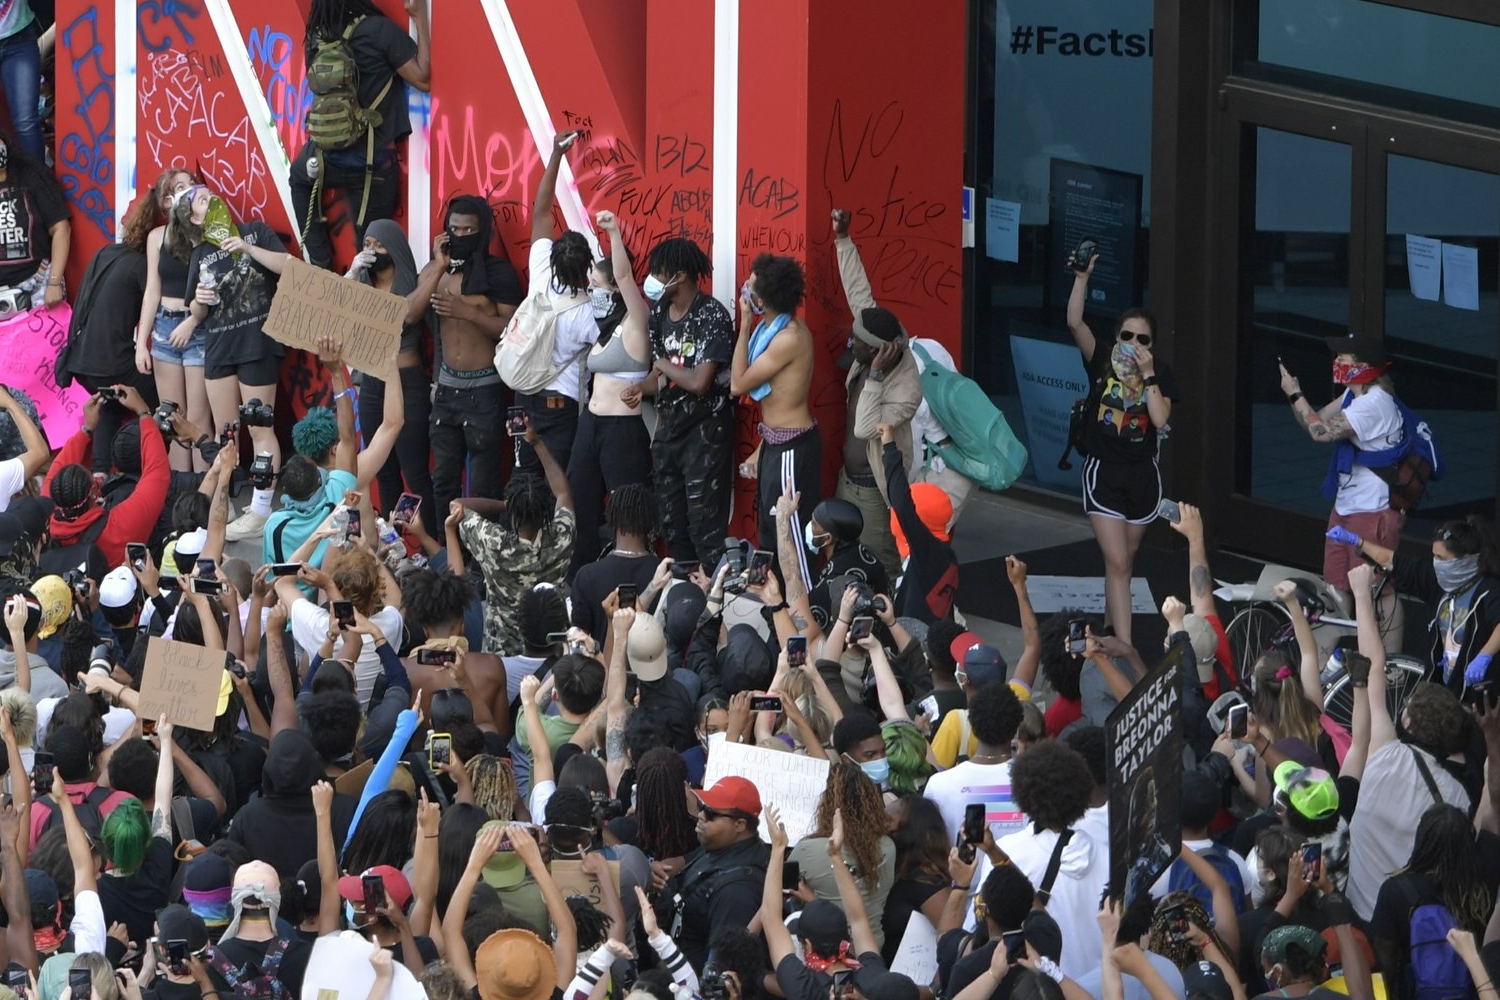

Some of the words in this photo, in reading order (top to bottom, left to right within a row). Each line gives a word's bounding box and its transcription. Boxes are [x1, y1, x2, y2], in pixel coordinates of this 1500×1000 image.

[248, 24, 293, 72] NO
[823, 97, 904, 190] NO
[617, 184, 673, 220] FUCK
[738, 168, 799, 220] ACAB
[812, 165, 947, 246] Jstice
[740, 226, 777, 251] WHEN
[291, 263, 316, 301] WE
[318, 276, 353, 308] STAND
[352, 287, 384, 320] WITH
[272, 294, 318, 345] BLACK
[349, 321, 396, 369] MATTER
[1037, 375, 1064, 389] ACCESS
[1065, 380, 1087, 393] ONLY
[1114, 675, 1163, 745] JUSTICE
[1163, 664, 1178, 684] FOR
[1114, 685, 1178, 769] BREONNA
[1120, 714, 1173, 785] TAYLOR
